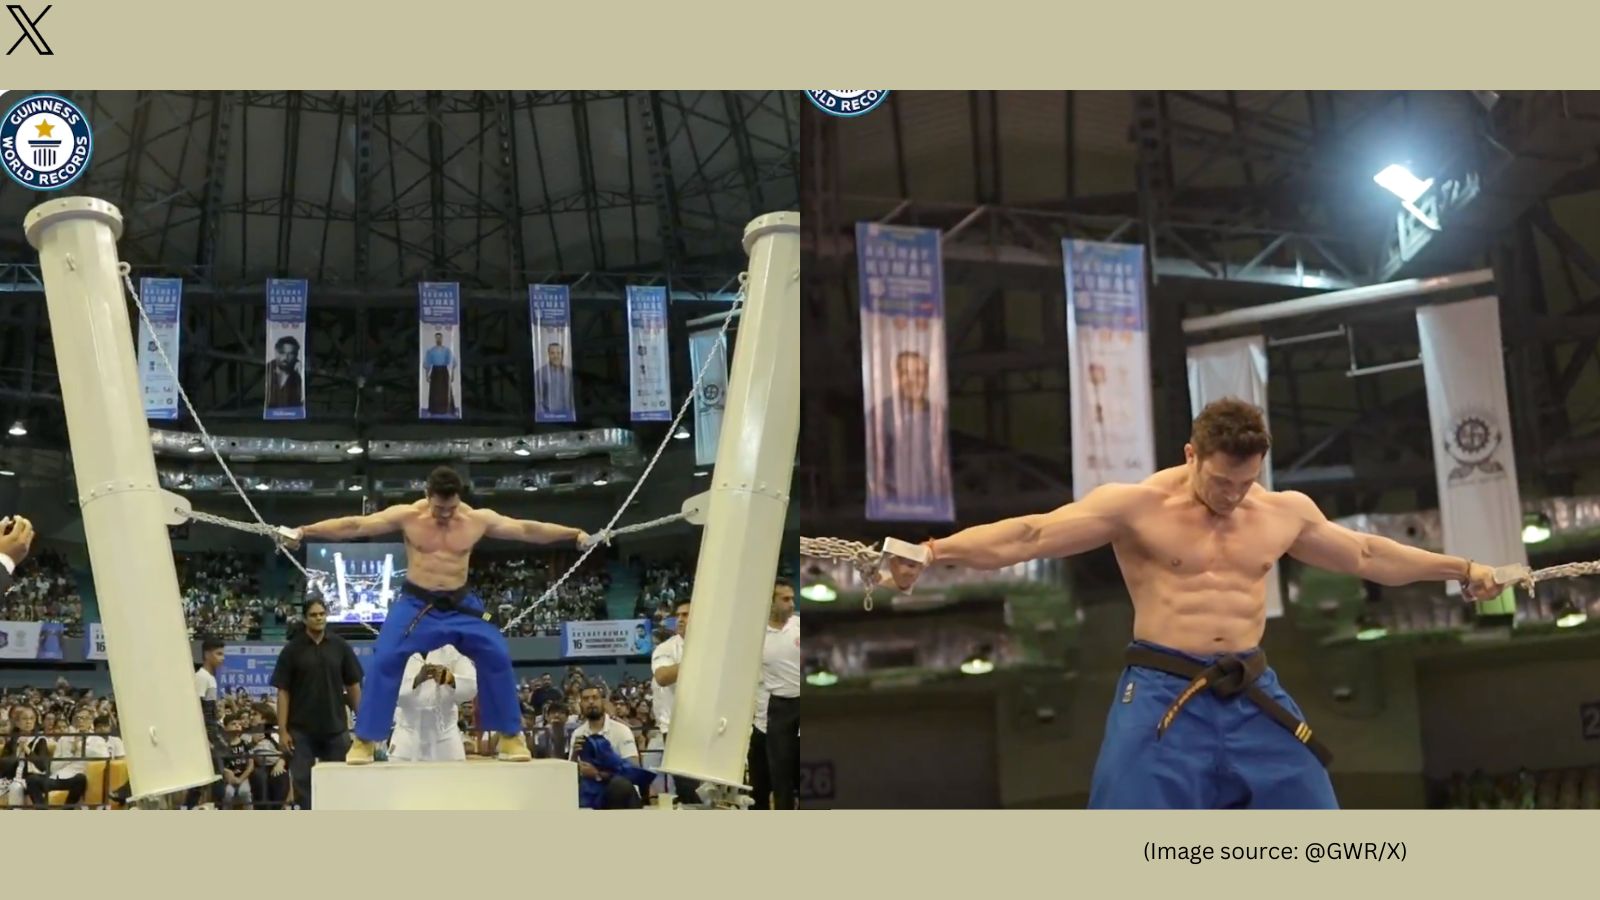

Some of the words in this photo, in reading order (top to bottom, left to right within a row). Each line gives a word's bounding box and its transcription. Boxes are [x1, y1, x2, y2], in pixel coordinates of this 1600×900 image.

[95, 641, 106, 653] 16
[573, 639, 583, 650] 16
[220, 673, 270, 685] AKSHAY
